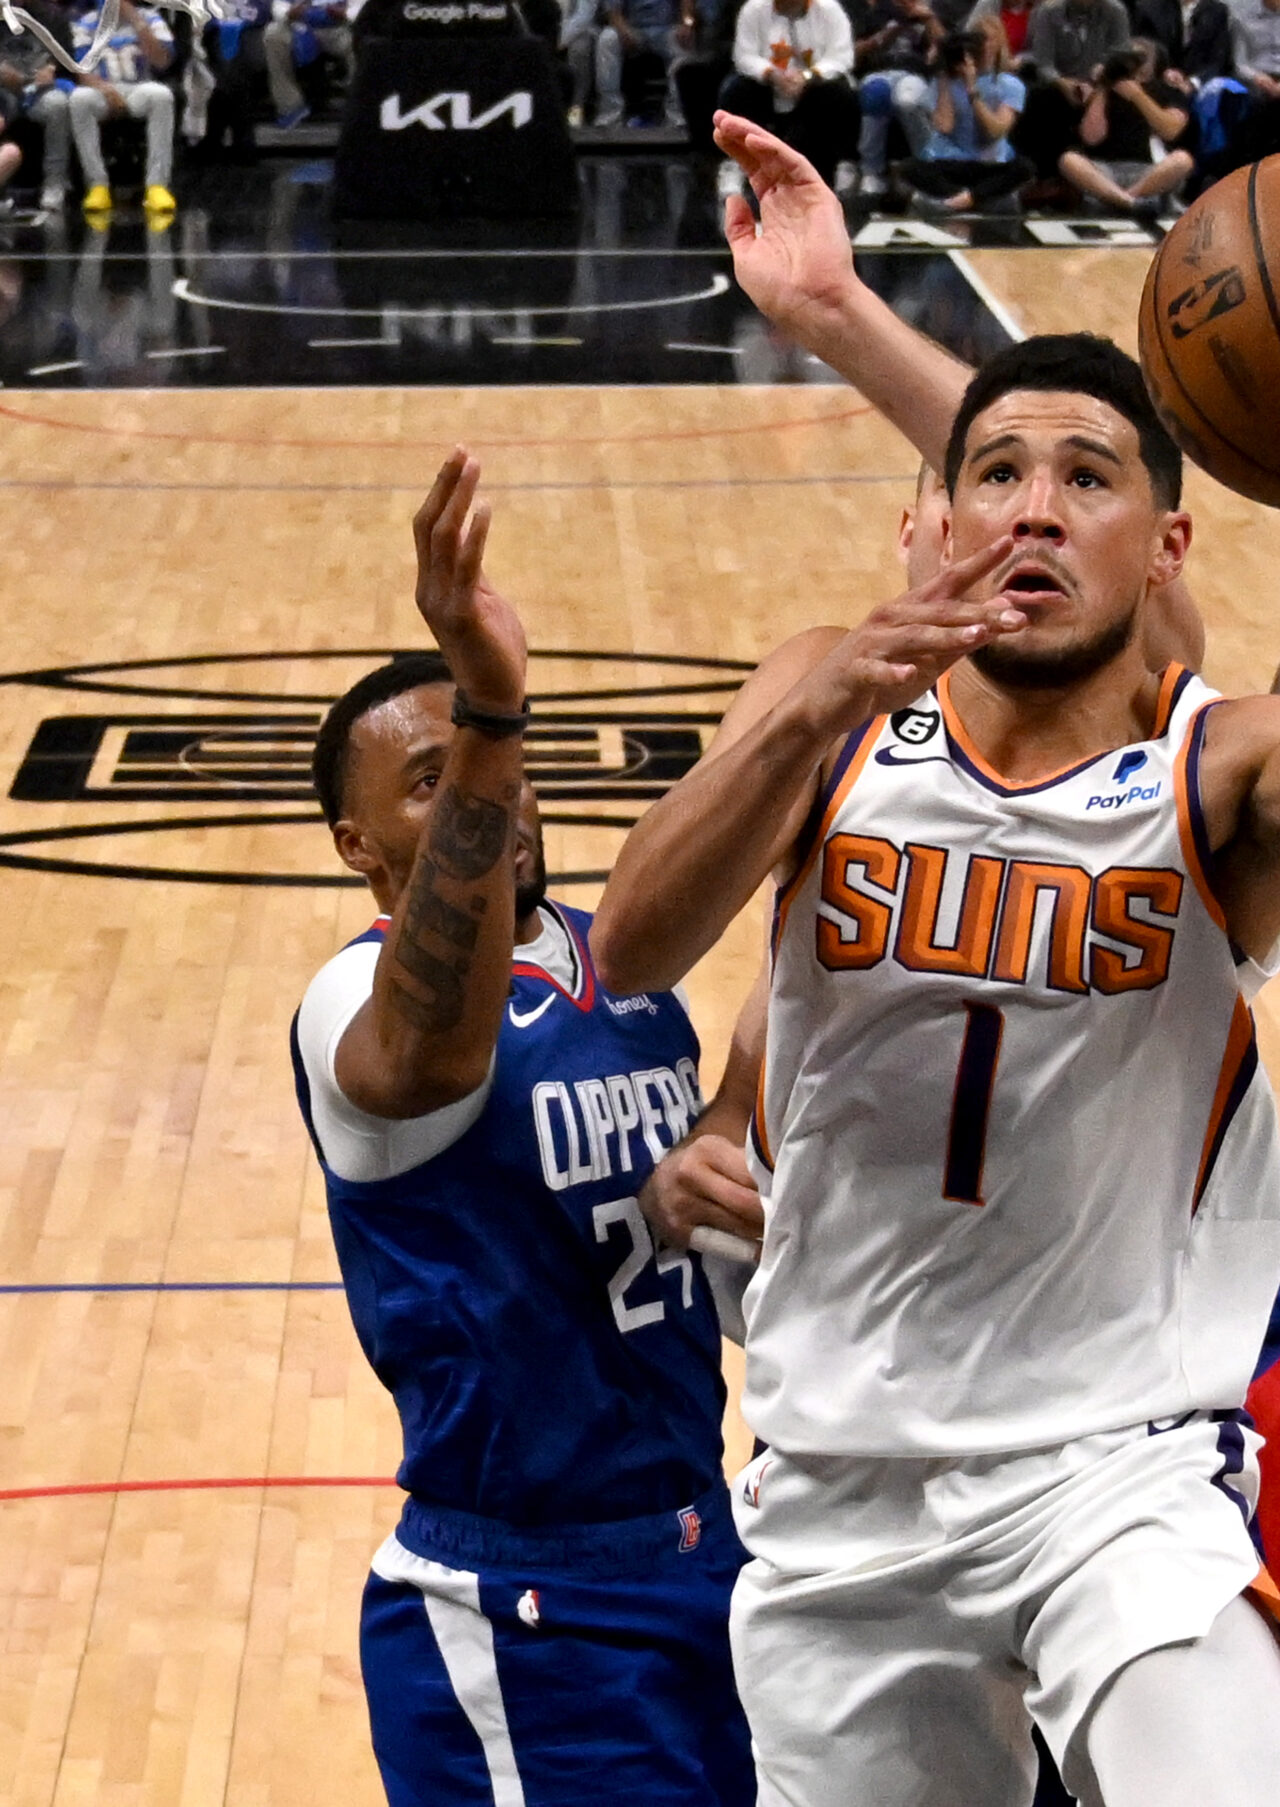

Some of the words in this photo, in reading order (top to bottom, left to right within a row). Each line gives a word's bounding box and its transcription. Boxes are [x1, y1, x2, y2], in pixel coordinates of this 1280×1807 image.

[403, 3, 465, 24] Google
[467, 3, 507, 20] Pixel
[380, 91, 533, 130] KIA
[898, 713, 933, 742] 6
[1085, 781, 1162, 811] PayPal
[603, 993, 660, 1016] honey
[940, 999, 1006, 1207] 1
